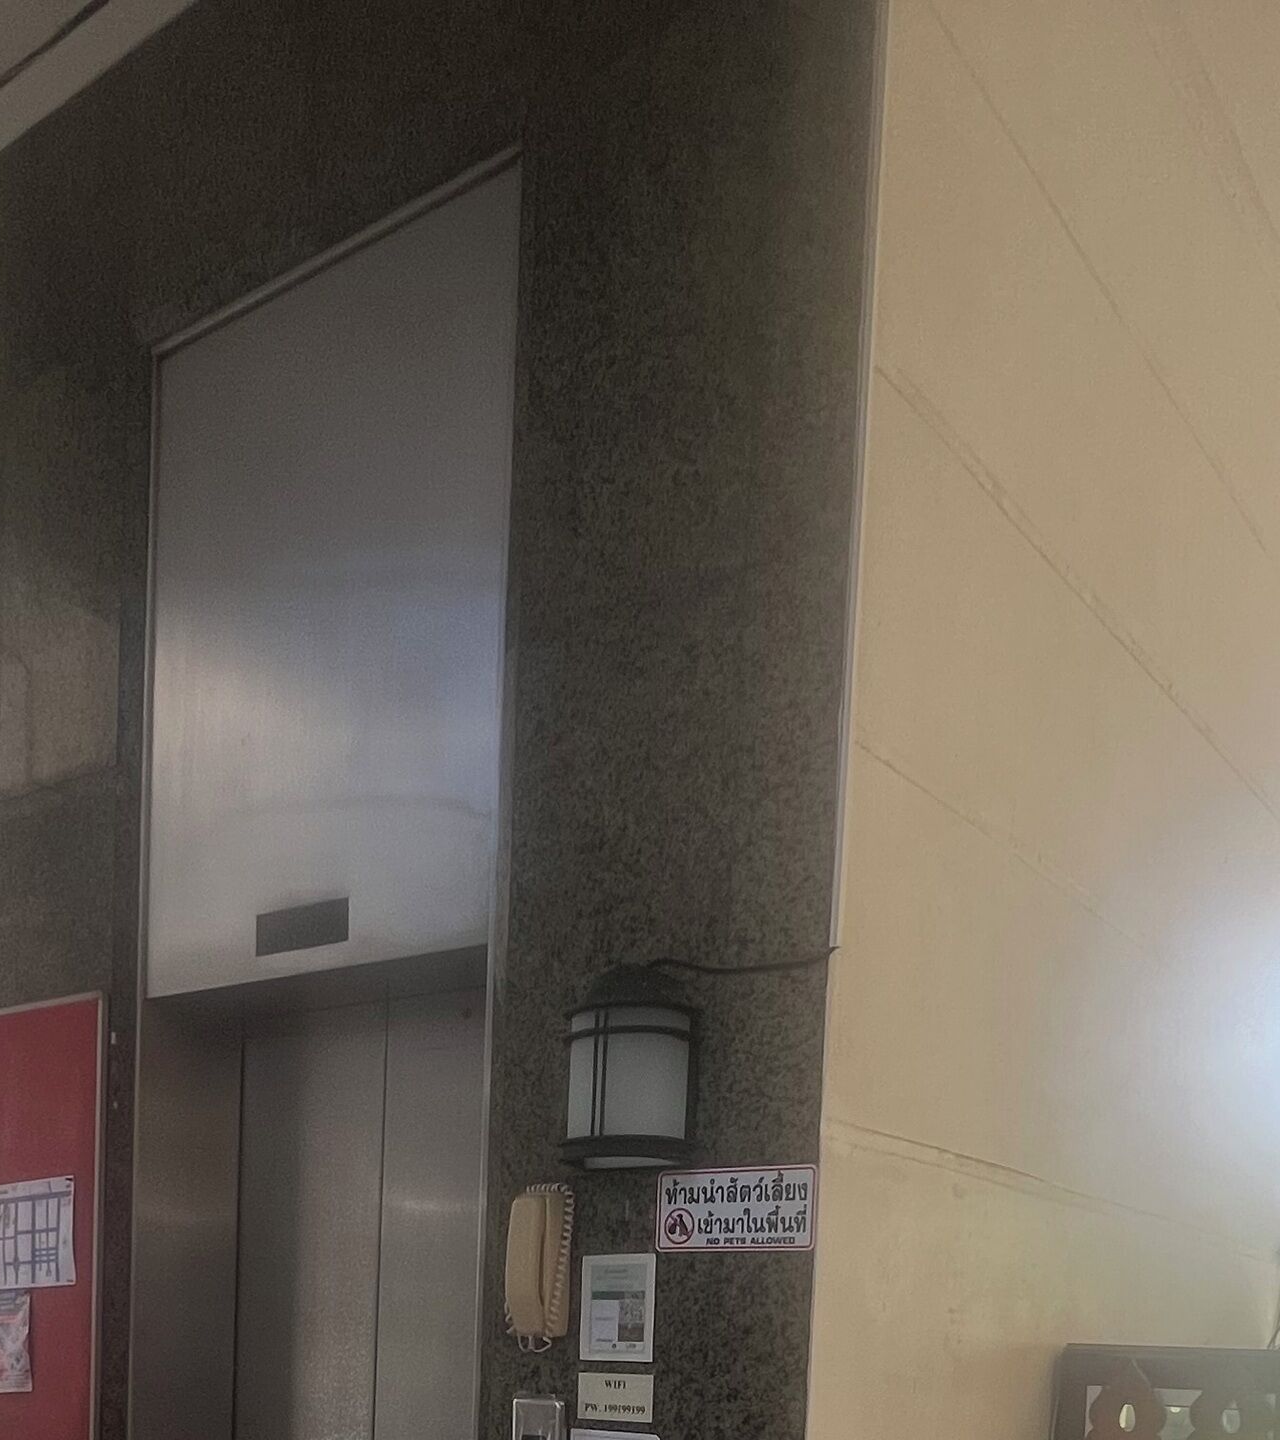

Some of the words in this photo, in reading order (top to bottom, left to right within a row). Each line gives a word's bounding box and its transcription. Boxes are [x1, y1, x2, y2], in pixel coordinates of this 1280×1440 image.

[697, 1204, 807, 1235] เข้ามาในพื้นที่
[705, 1237, 720, 1246] NO
[723, 1237, 746, 1245] PETS
[750, 1236, 796, 1245] ALLOWED
[604, 1379, 626, 1390] WIFI
